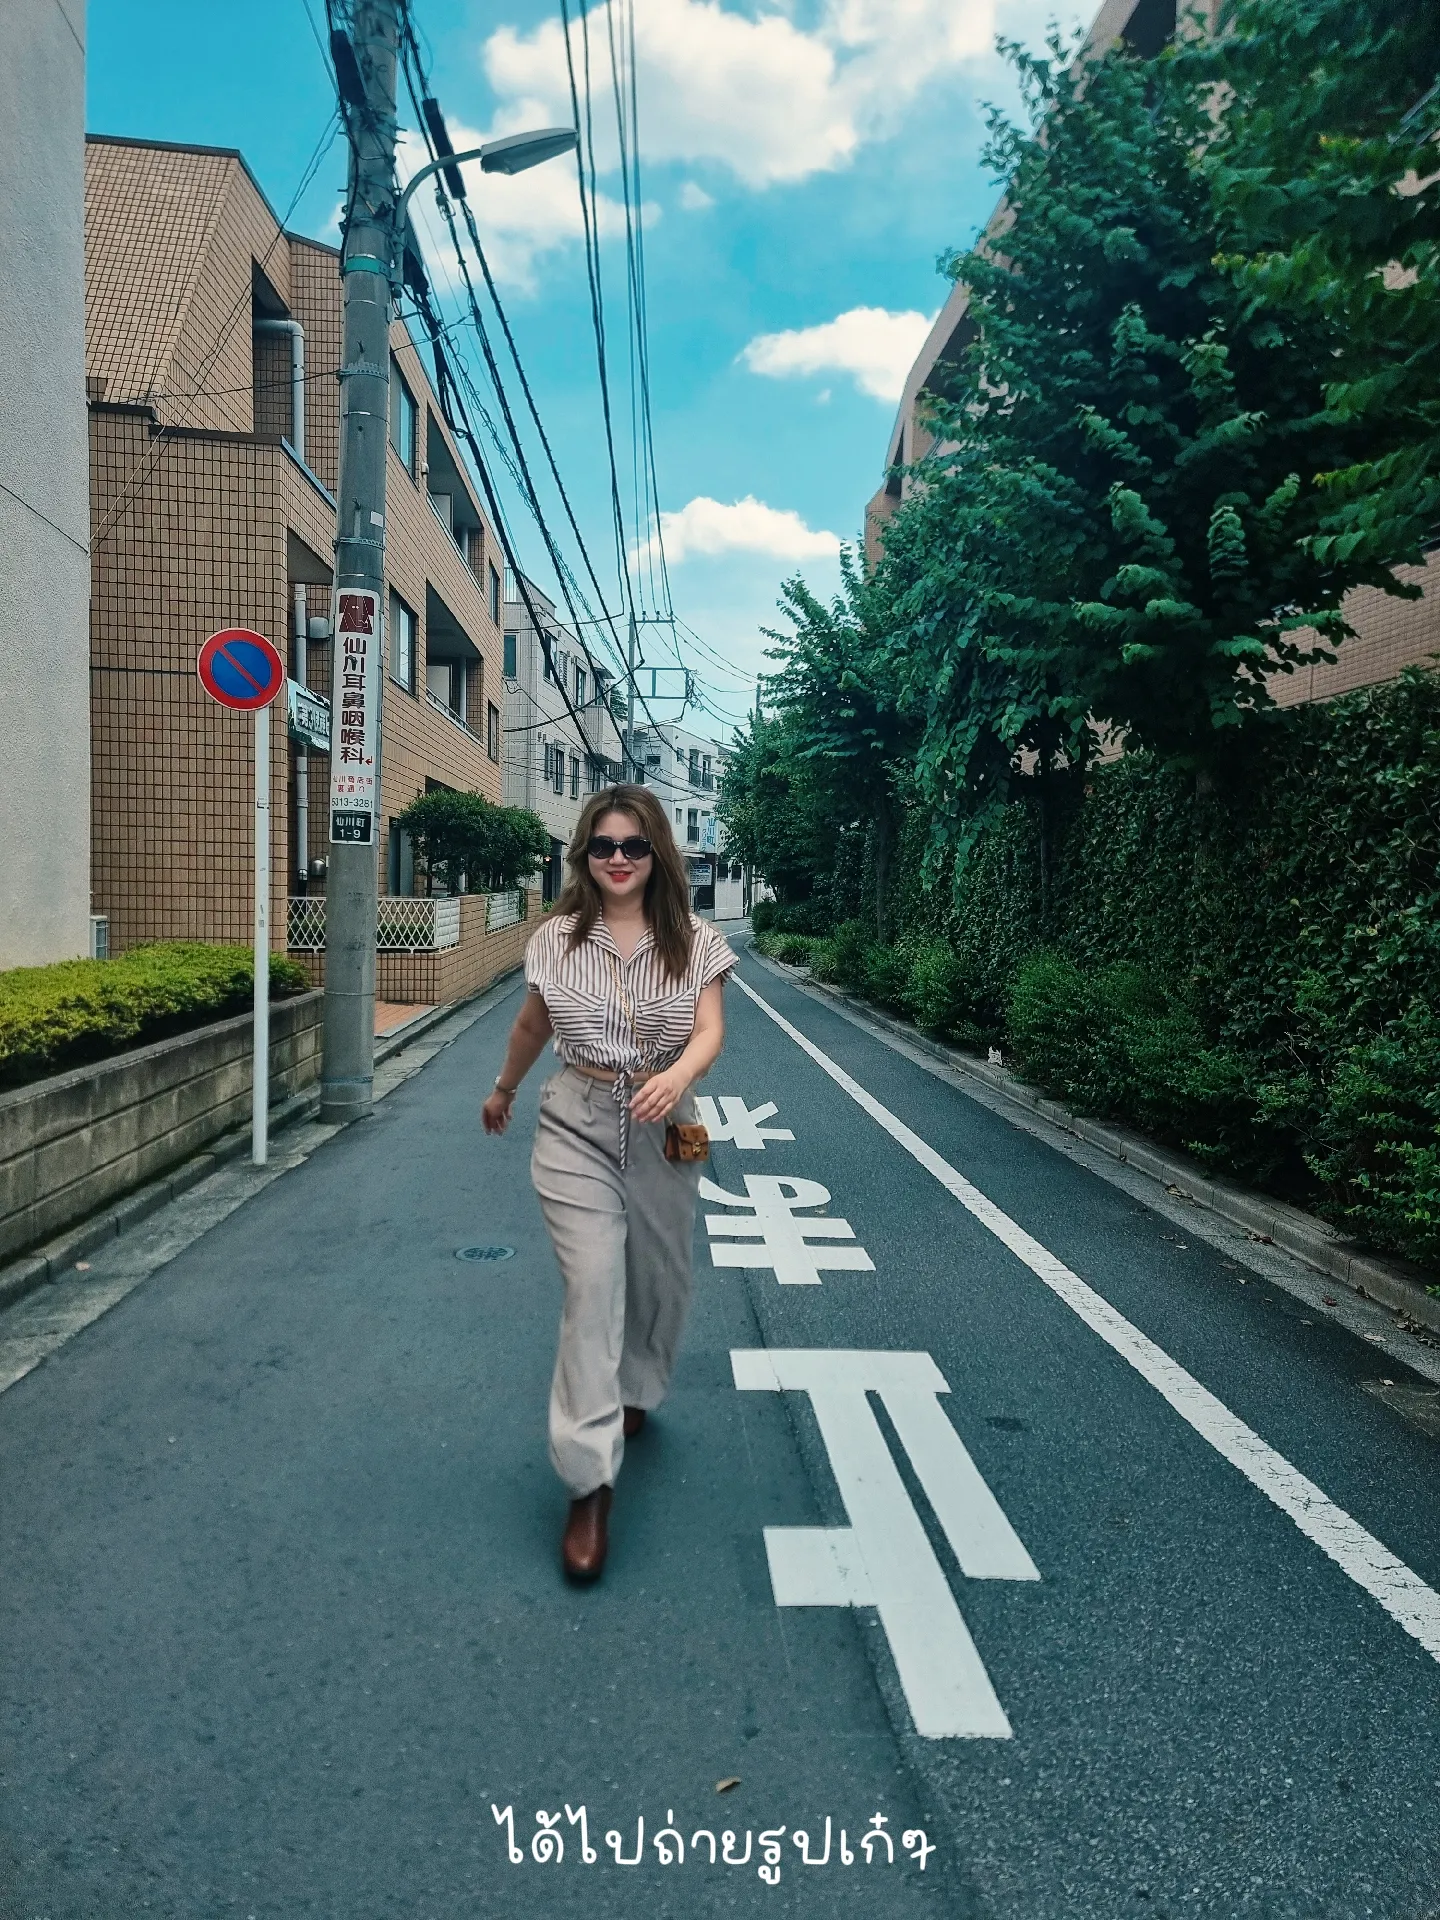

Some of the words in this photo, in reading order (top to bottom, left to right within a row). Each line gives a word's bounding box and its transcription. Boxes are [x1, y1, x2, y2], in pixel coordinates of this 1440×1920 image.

[340, 637, 367, 765] 仙川耳鼻咽喉科
[335, 816, 366, 828] 仙川町
[339, 828, 361, 839] 1-9
